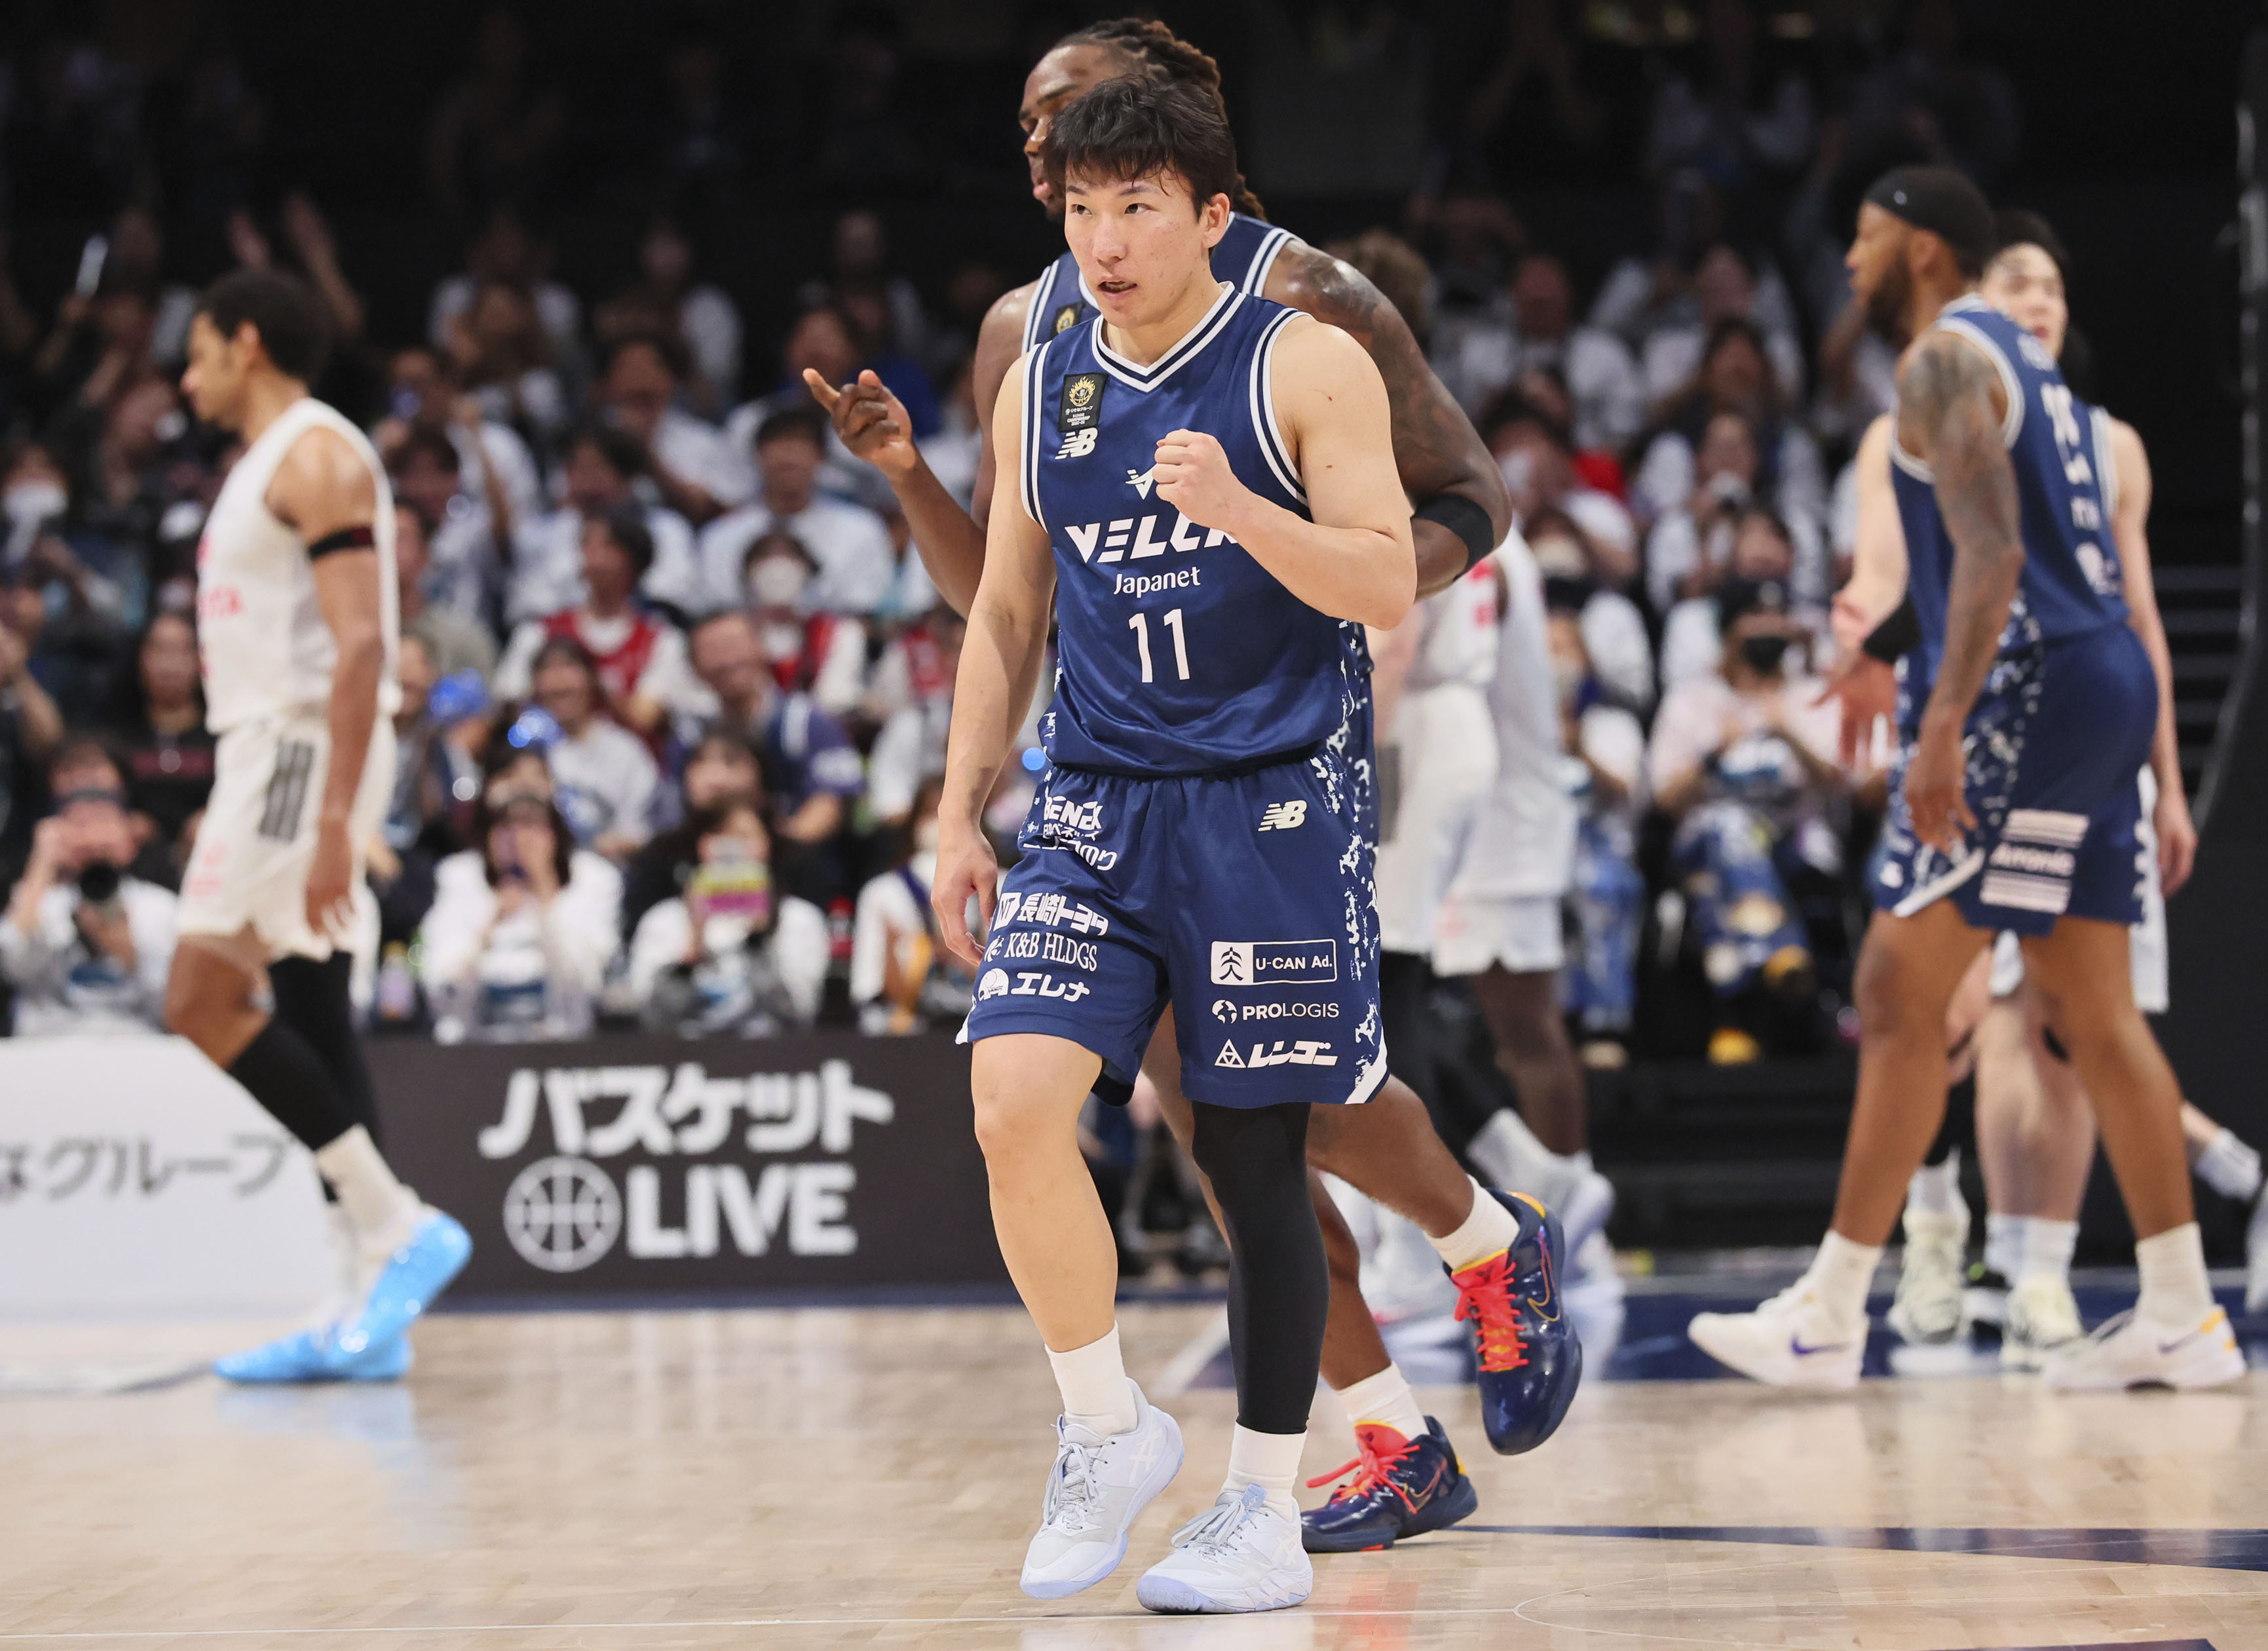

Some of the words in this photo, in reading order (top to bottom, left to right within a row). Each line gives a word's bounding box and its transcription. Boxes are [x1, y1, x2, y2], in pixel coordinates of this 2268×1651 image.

[1113, 567, 1201, 599] Japanet
[1128, 608, 1190, 683] 11
[1016, 892, 1109, 936] 長崎トヨタ
[1004, 932, 1041, 958] K&B
[1042, 932, 1098, 972] HLDGS
[1255, 957, 1306, 970] U-CAN
[1311, 955, 1333, 968] Ad.
[1011, 972, 1091, 1002] エレナ
[1242, 1002, 1340, 1021] PROLOGIS
[1247, 1040, 1338, 1069] レンゴー
[477, 1057, 896, 1159] バスケット
[625, 1162, 858, 1259] LIVE
